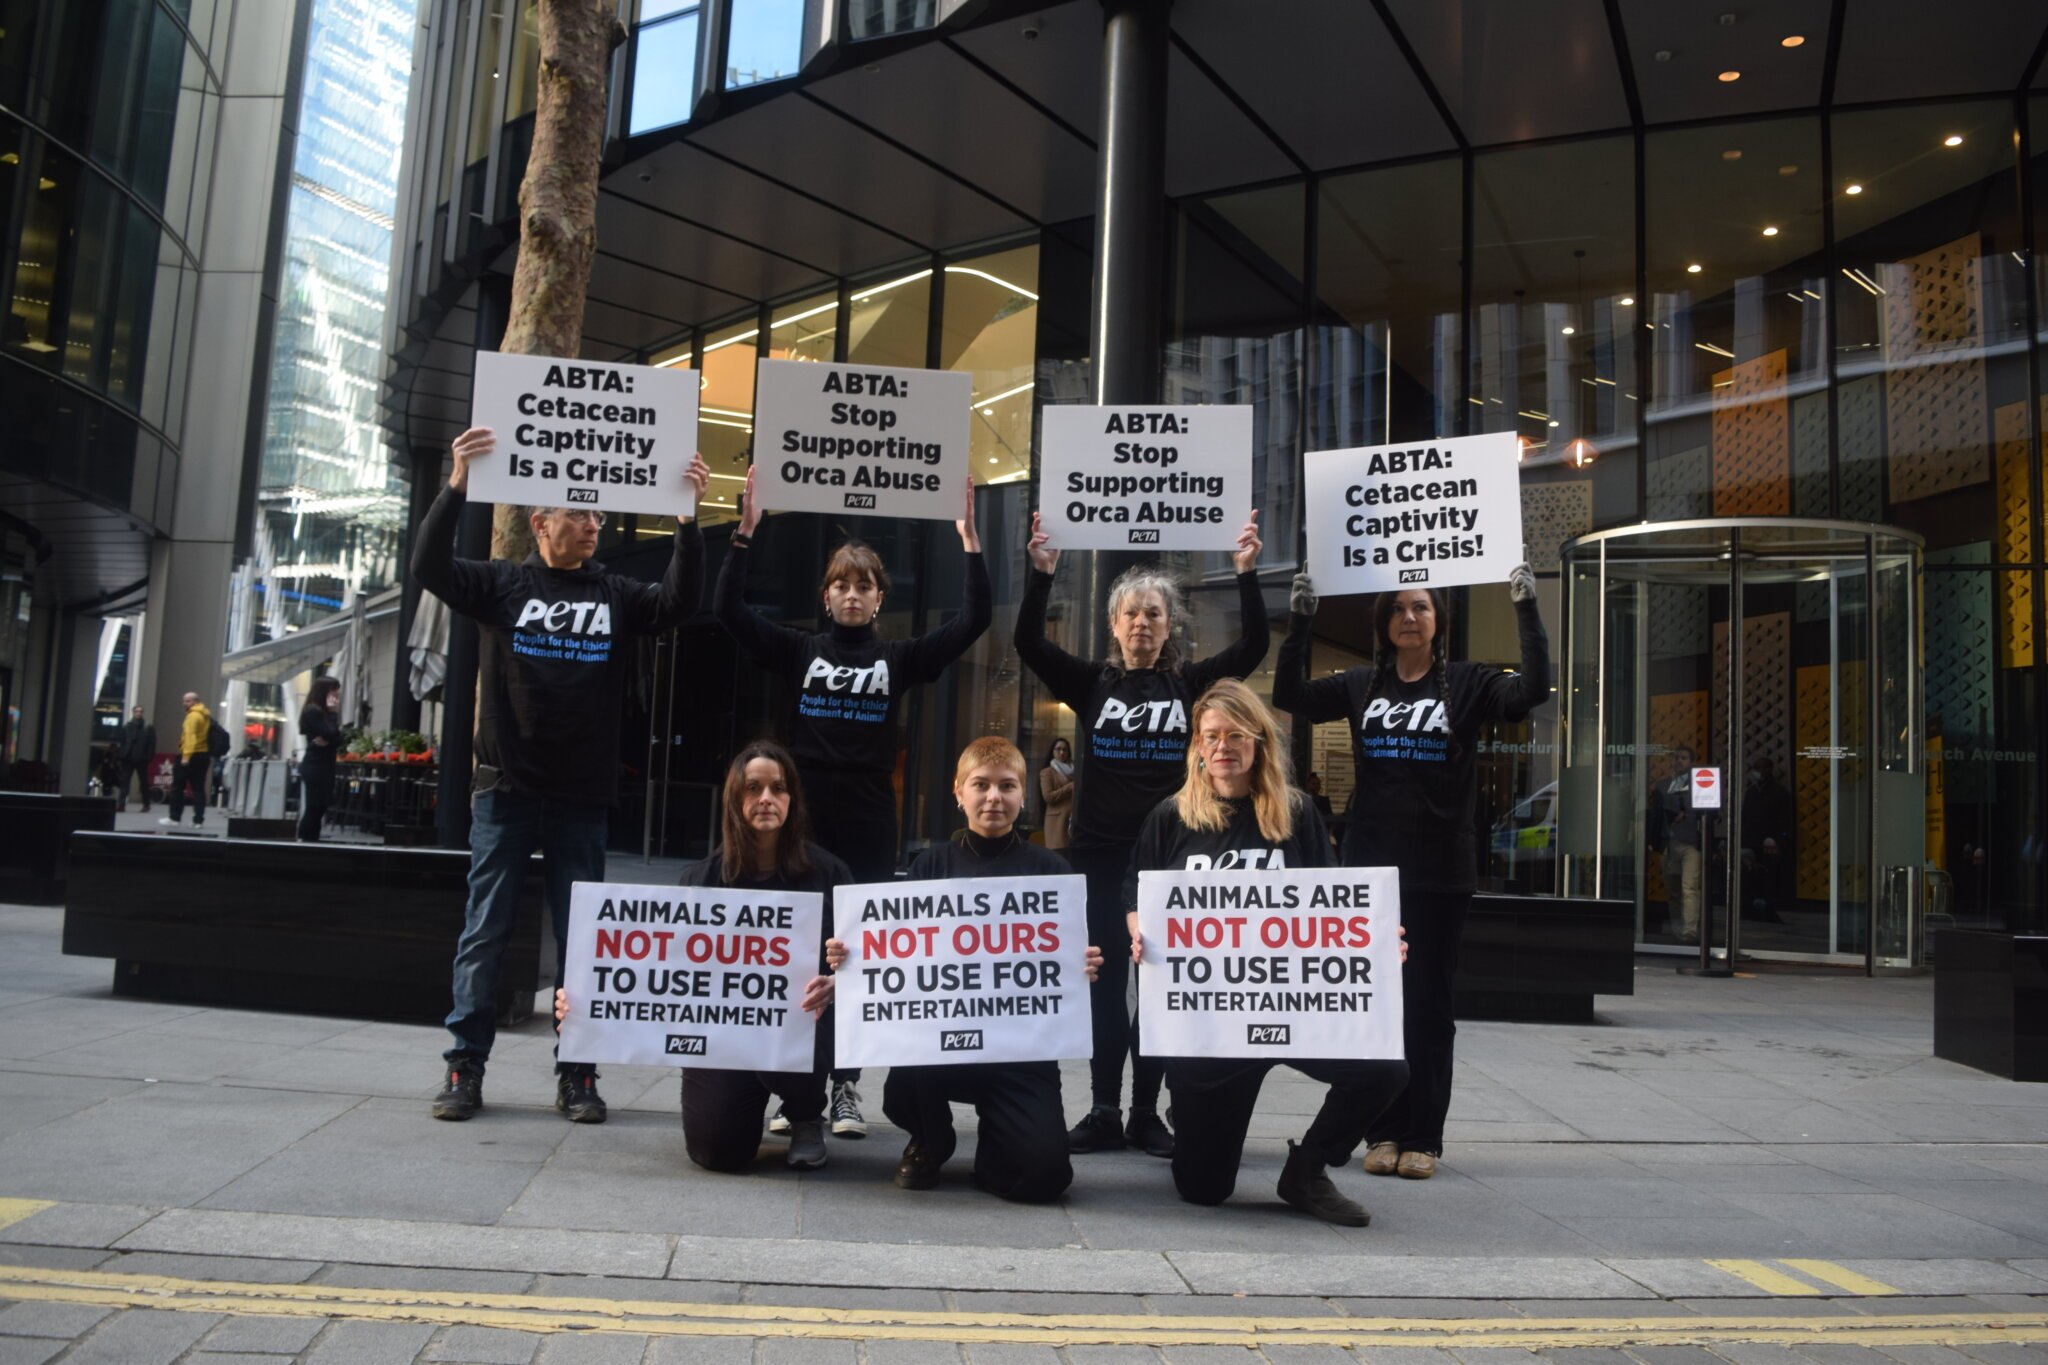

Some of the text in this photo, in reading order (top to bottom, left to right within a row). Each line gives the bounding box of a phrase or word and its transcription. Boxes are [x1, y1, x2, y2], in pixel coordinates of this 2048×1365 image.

[543, 365, 634, 393] ABTA:
[822, 371, 908, 398] ABTA:
[517, 393, 656, 425] Cetacean
[831, 402, 897, 431] Stop
[1105, 413, 1188, 434] ABTA:
[515, 423, 656, 460] Captivity
[782, 430, 941, 465] Supporting
[1113, 442, 1178, 467] Stop
[509, 454, 658, 486] Is a Crisis!
[1367, 448, 1452, 476] ABTA:
[781, 461, 941, 492] Orca Abuse
[1067, 471, 1224, 498] Supporting
[1345, 478, 1477, 507] Cetacean
[1066, 501, 1224, 523] Orca Abuse
[1346, 506, 1479, 538] Captivity
[1343, 534, 1484, 567] Is a Crisis!
[513, 632, 611, 651] People for the Ethical
[513, 643, 609, 662] Treatment of Animal
[799, 704, 885, 722] Treatment of Animal
[801, 693, 826, 707] People
[828, 695, 840, 707] for
[844, 698, 860, 708] the
[1092, 734, 1120, 748] People
[1124, 738, 1136, 748] for
[1140, 739, 1156, 748] the
[1093, 746, 1137, 759] Treatment
[1140, 750, 1150, 759] of
[1386, 735, 1398, 745] for
[1400, 736, 1415, 747] the
[1418, 738, 1447, 749] Ethical
[1401, 749, 1410, 758] of
[1412, 750, 1446, 761] Animals
[1492, 740, 1575, 755] Fenchur
[1971, 748, 2037, 762] Avenue
[861, 891, 1059, 922] ANIMALS ARE
[1166, 884, 1371, 909] ANIMALS ARE
[597, 899, 793, 929] ANIMALS ARE
[862, 921, 1060, 960] NOT OURS
[1167, 916, 1371, 949] NOT OURS
[595, 928, 790, 967] NOT OURS
[593, 966, 788, 1001] TO USE FOR
[862, 960, 1062, 995] TO USE FOR
[1166, 956, 1372, 985] TO USE FOR
[589, 1000, 788, 1027] ENTERTAINMENT
[862, 994, 1063, 1022] ENTERTAINMENT
[1167, 991, 1373, 1013] ENTERTAINMENT
